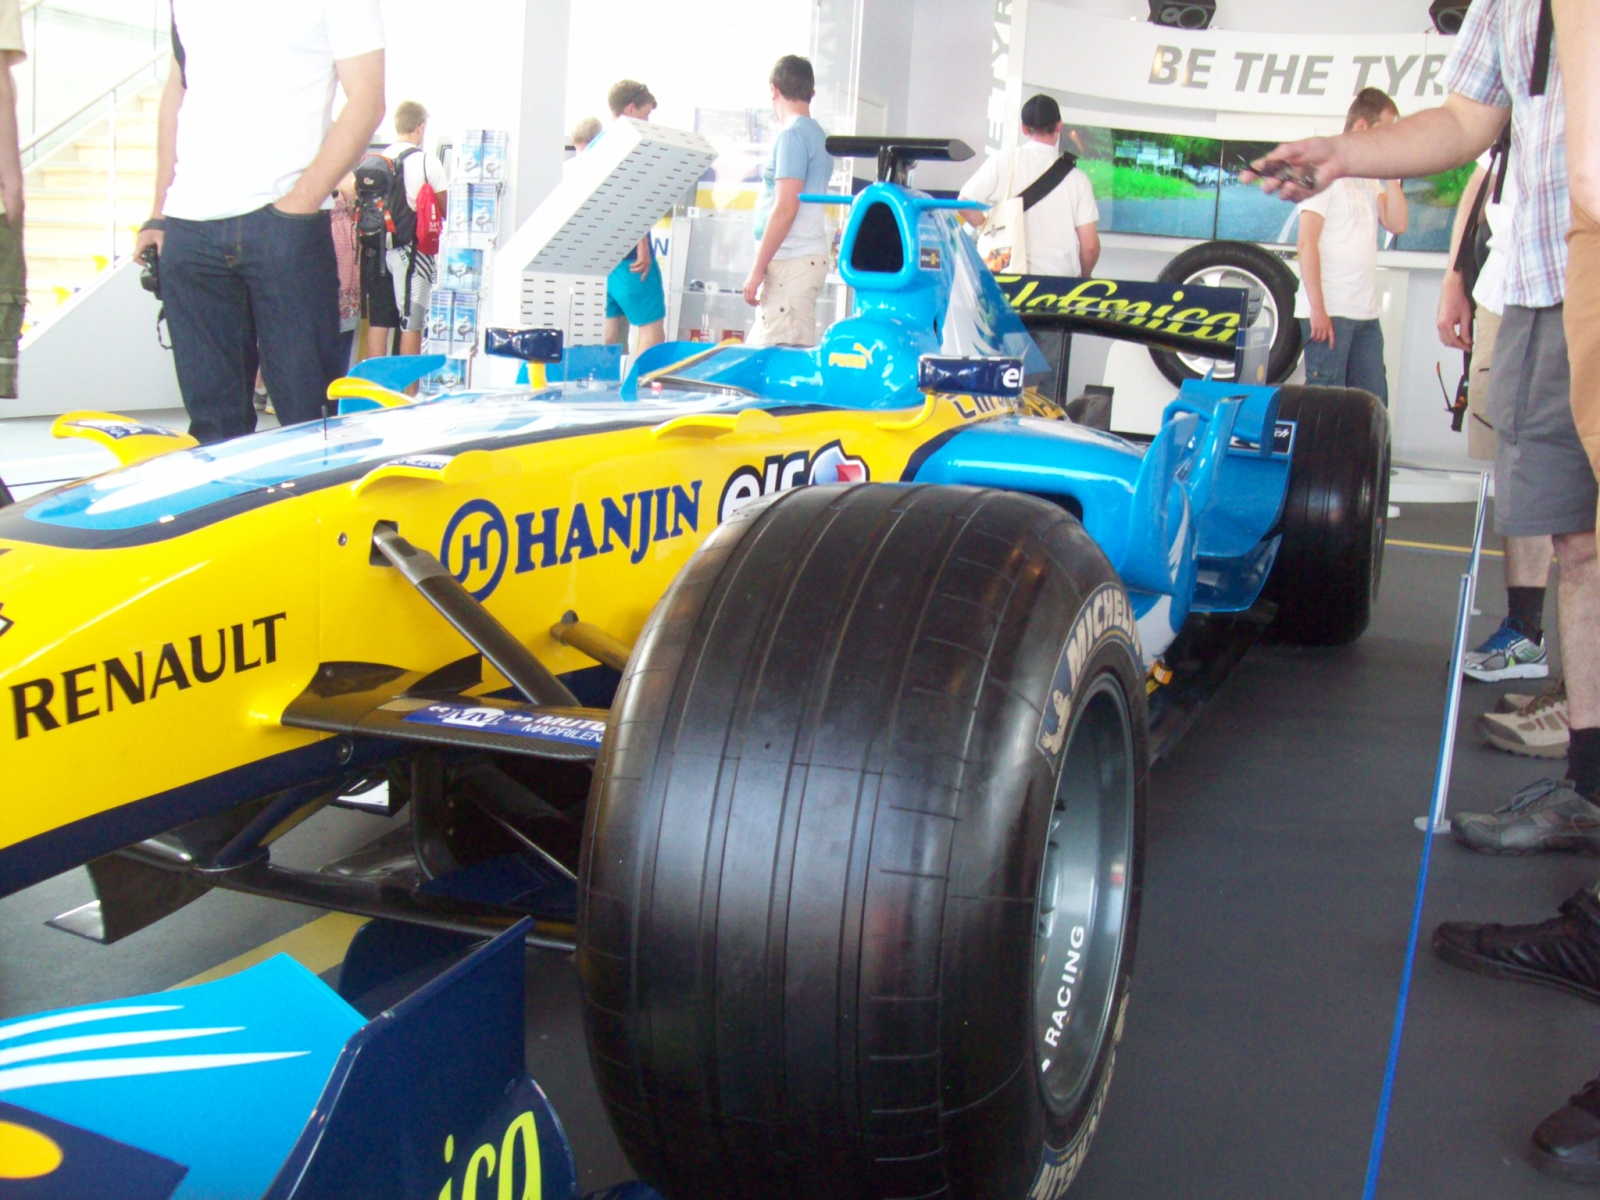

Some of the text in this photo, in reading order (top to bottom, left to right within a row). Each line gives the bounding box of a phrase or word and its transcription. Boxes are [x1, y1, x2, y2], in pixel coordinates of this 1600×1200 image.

[1148, 44, 1451, 97] BE THE TYR
[515, 480, 702, 574] HANJIN
[9, 611, 286, 740] RENAULT
[520, 723, 603, 742] MADRILEN
[534, 715, 606, 731] MUTU
[1044, 926, 1084, 1048] RACING
